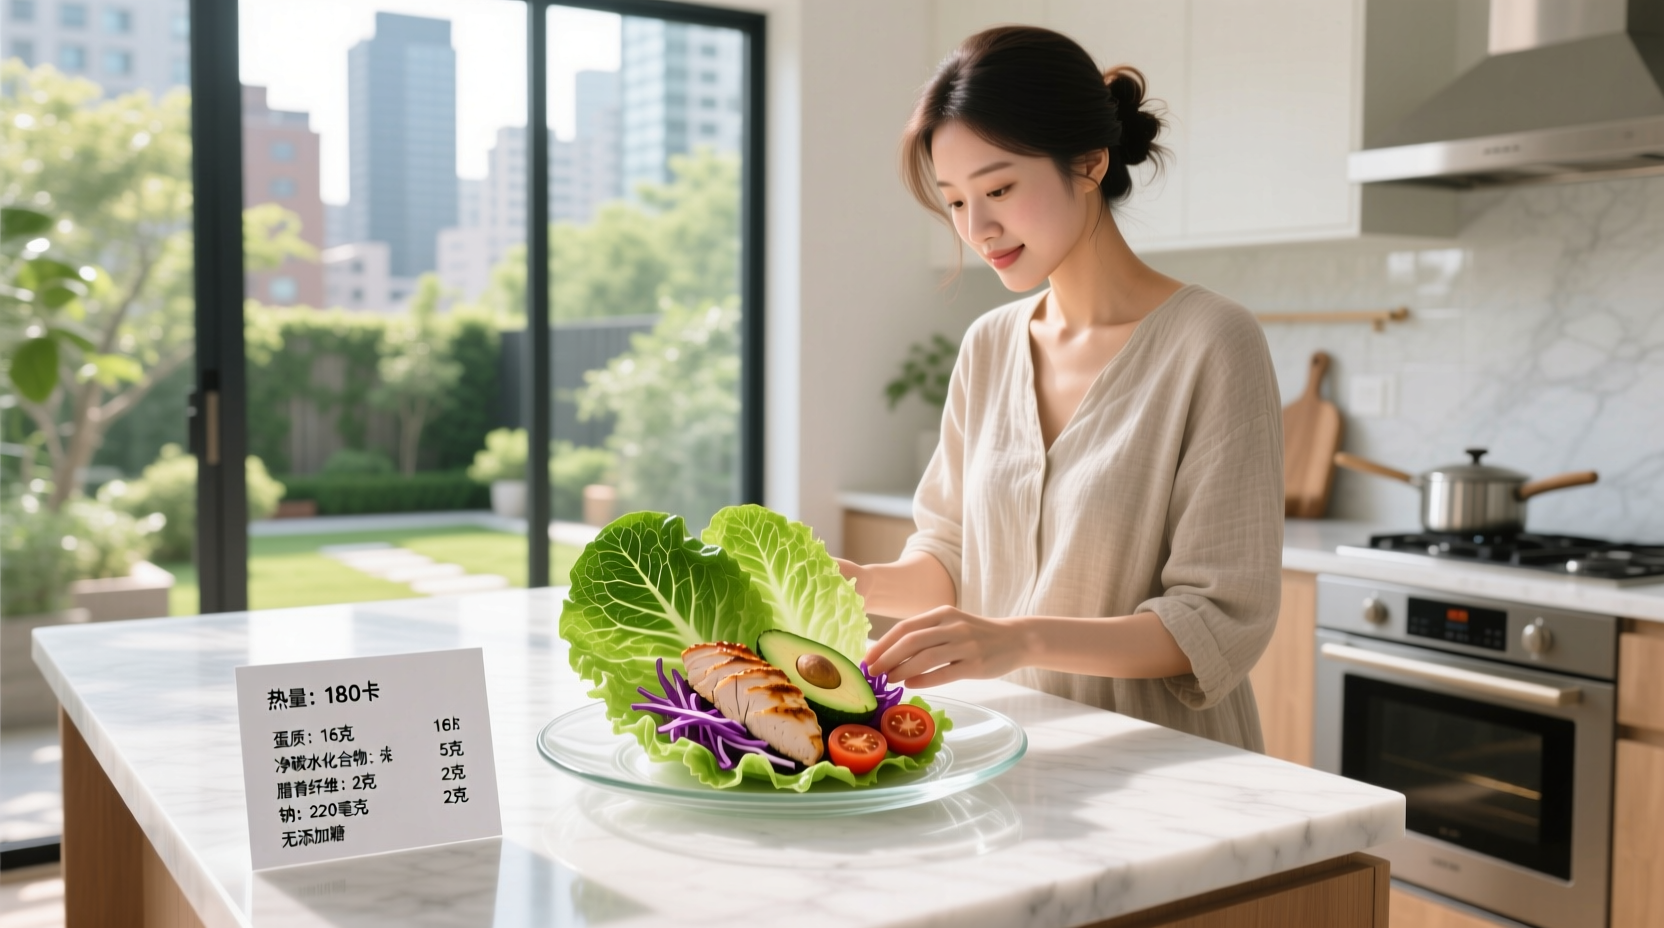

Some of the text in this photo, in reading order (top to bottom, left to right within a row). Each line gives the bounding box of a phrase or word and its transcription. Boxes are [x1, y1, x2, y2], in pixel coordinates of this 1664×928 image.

[267, 681, 380, 711] 热量：180卡
[439, 740, 465, 758] 5克
[441, 762, 467, 782] 2克
[443, 785, 470, 805] 2克
